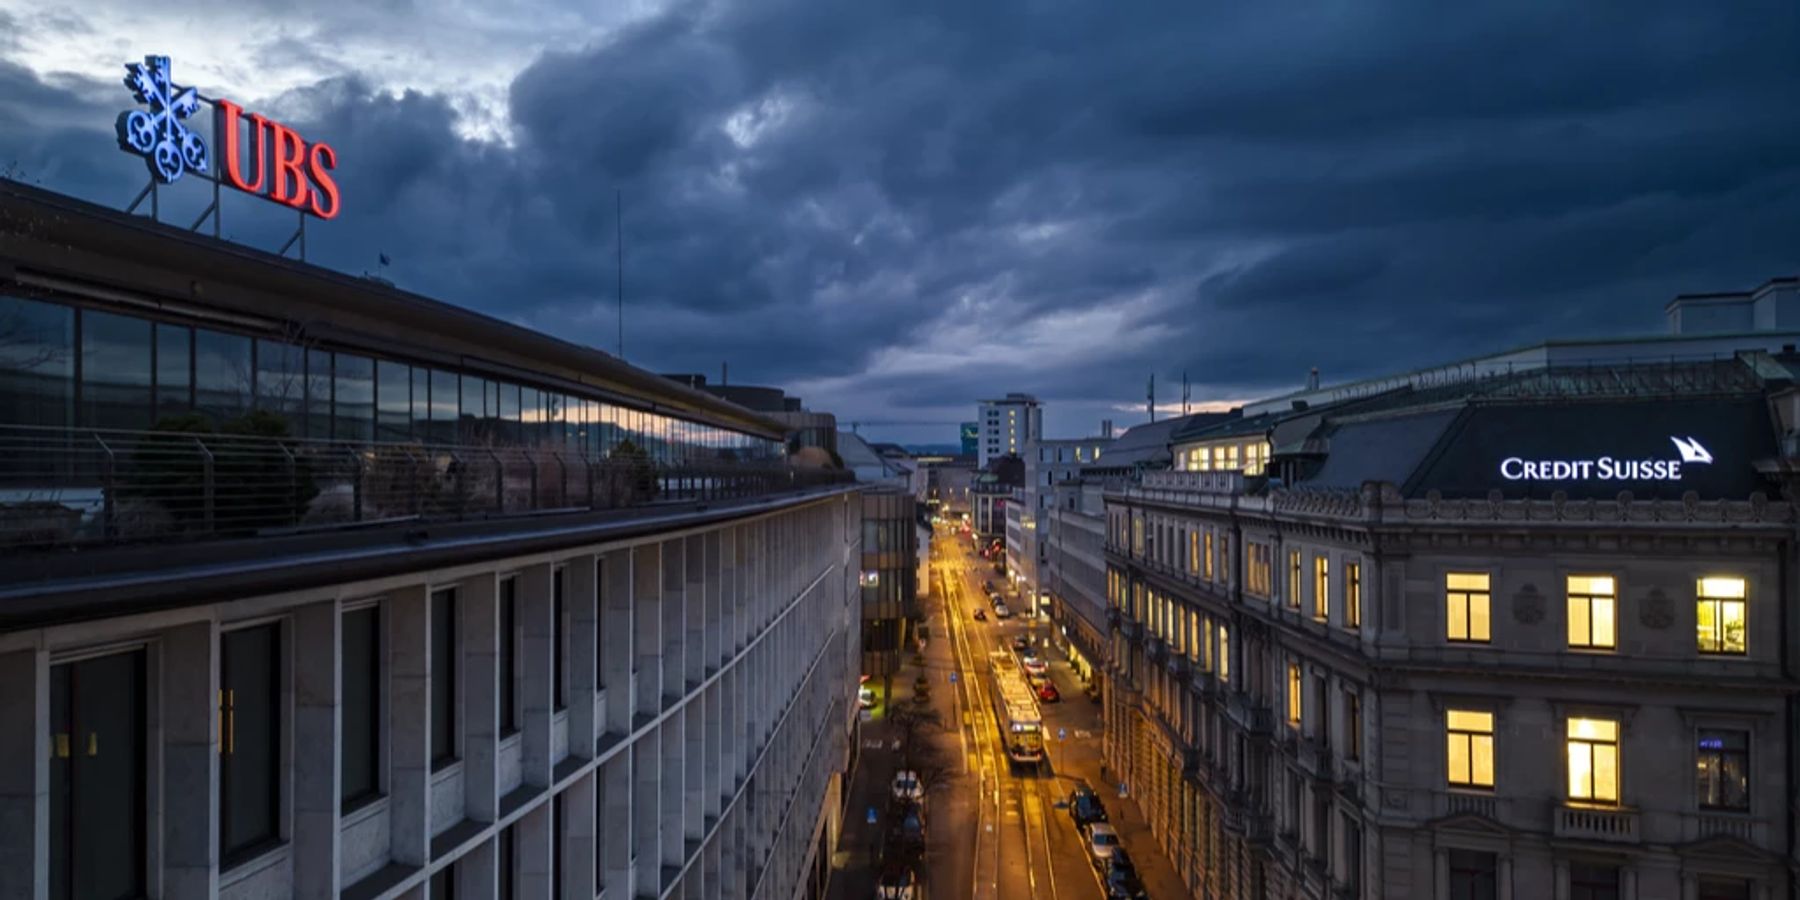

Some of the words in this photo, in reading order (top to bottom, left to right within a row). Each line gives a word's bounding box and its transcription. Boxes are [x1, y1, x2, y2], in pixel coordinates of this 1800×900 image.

[216, 98, 340, 220] UBS
[1501, 457, 1594, 480] CREDIT
[1597, 456, 1682, 480] SUISSE
